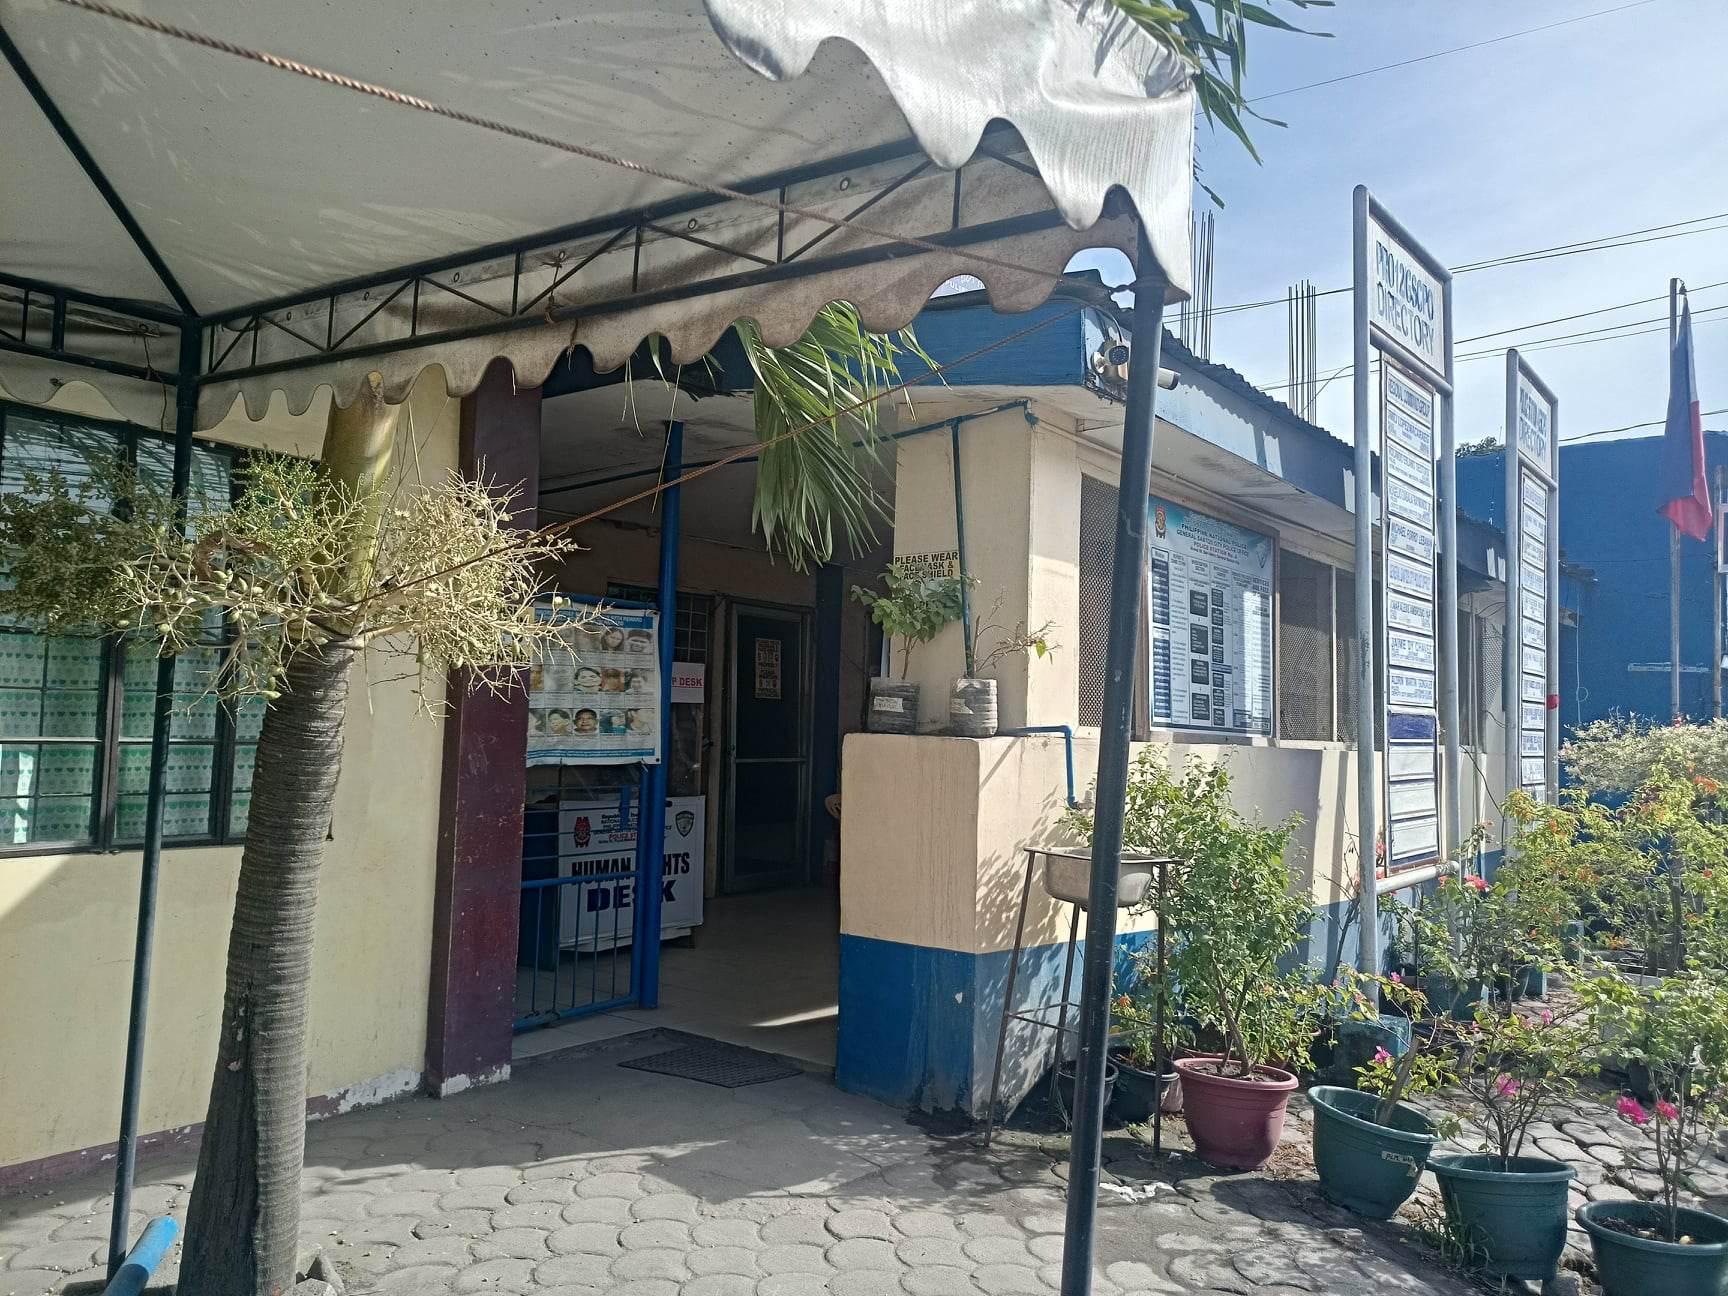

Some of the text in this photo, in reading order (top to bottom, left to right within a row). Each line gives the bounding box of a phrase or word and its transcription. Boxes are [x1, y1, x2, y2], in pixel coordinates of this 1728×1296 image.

[1377, 281, 1434, 356] DIRECTORY
[1176, 529, 1196, 540] GENERAL
[1182, 523, 1208, 536] PHILIPPINE
[1209, 533, 1231, 545] NATIONAL
[895, 551, 958, 565] PLEASE WEAR
[900, 560, 954, 572] FAC ASK &
[680, 677, 703, 687] DESK
[571, 852, 690, 883] HUMAN HTS
[587, 879, 677, 912] DEK
